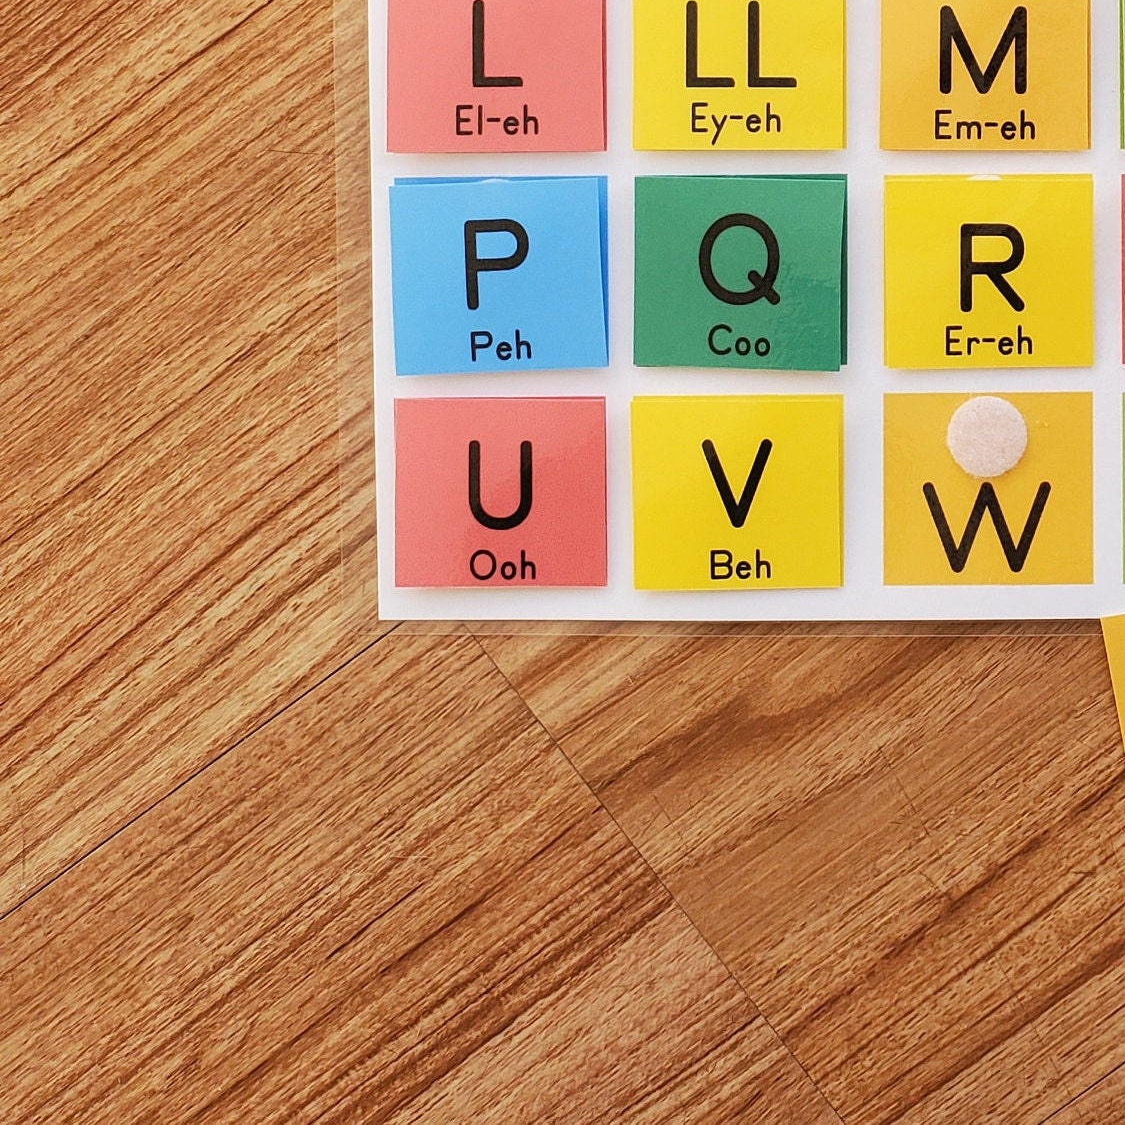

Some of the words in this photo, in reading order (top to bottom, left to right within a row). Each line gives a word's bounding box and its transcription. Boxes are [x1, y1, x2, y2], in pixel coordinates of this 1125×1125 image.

[471, 0, 524, 88] L
[685, 0, 798, 88] LL
[939, 5, 1028, 95] M
[455, 104, 539, 136] El-eh
[691, 102, 781, 146] Ey-eh
[934, 109, 1036, 141] Em-eh
[463, 218, 530, 311] P
[698, 212, 781, 306] Q
[960, 223, 1025, 313] R
[470, 329, 532, 362] Peh
[707, 323, 771, 357] Coo
[945, 324, 1033, 356] Er-eh
[468, 440, 533, 531] U
[701, 438, 773, 529] V
[922, 481, 1052, 574] W
[469, 549, 537, 581] Ooh
[710, 548, 771, 580] Beh
